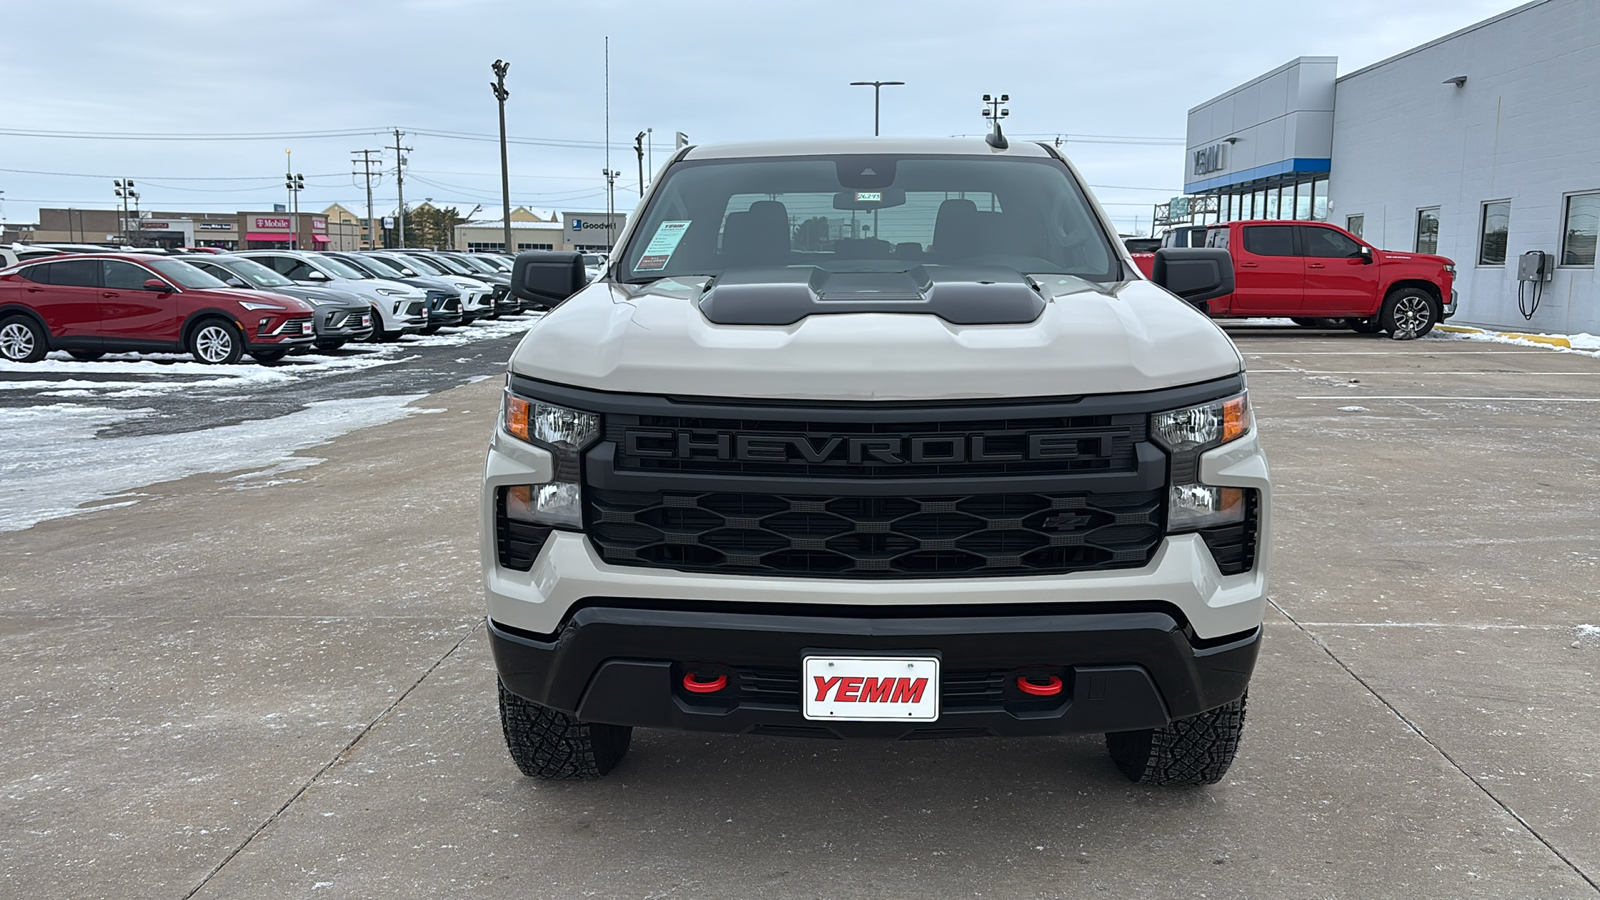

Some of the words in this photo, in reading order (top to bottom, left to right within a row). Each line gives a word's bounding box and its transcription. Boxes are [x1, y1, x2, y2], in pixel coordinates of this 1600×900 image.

[264, 219, 289, 228] Mobile
[582, 222, 617, 230] Goodwil
[623, 427, 1132, 465] CHEVROLET
[813, 676, 930, 704] YEMM
